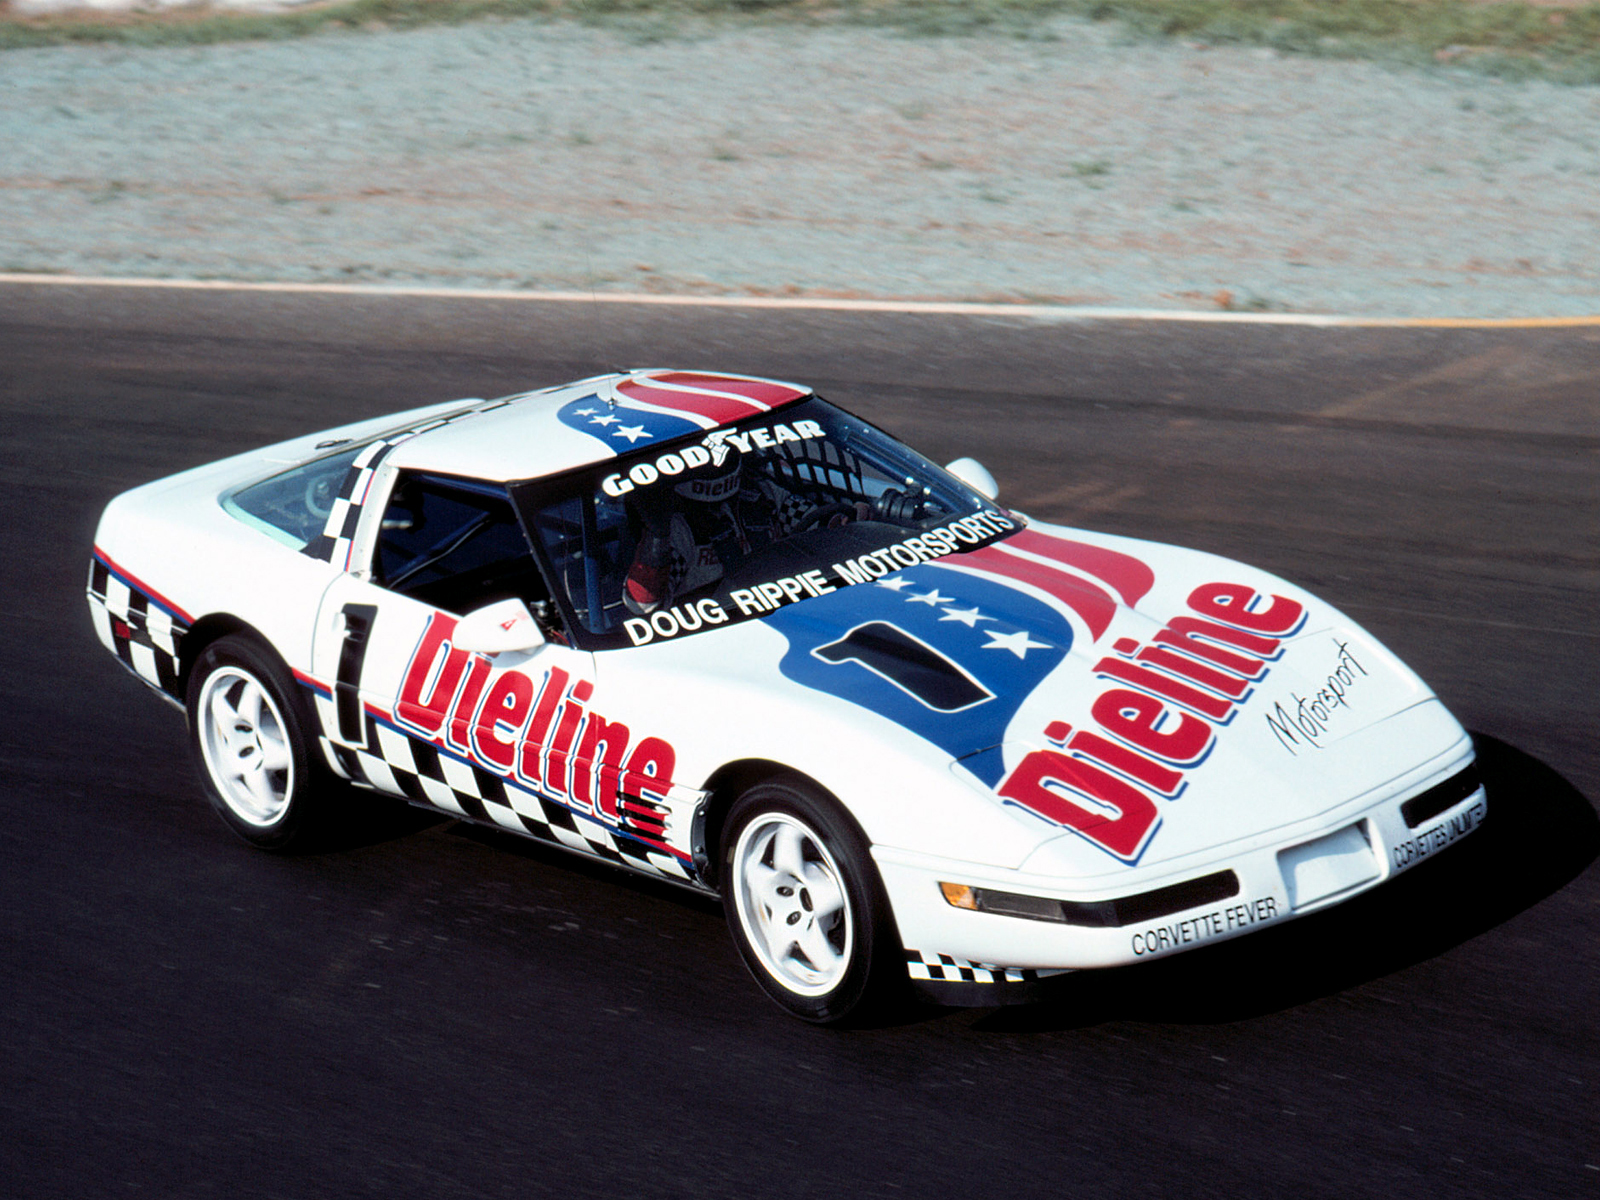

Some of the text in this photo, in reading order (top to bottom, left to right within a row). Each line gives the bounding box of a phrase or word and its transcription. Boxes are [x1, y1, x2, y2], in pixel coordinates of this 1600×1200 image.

[601, 420, 826, 497] GOODYEAR
[623, 509, 1014, 647] DOUG RIPPIE MOTORSPORTS
[393, 611, 676, 838] Dieline
[996, 581, 1308, 867] Dieline
[1265, 638, 1368, 757] Motorsport
[1132, 896, 1278, 956] CORVETTE FEVER
